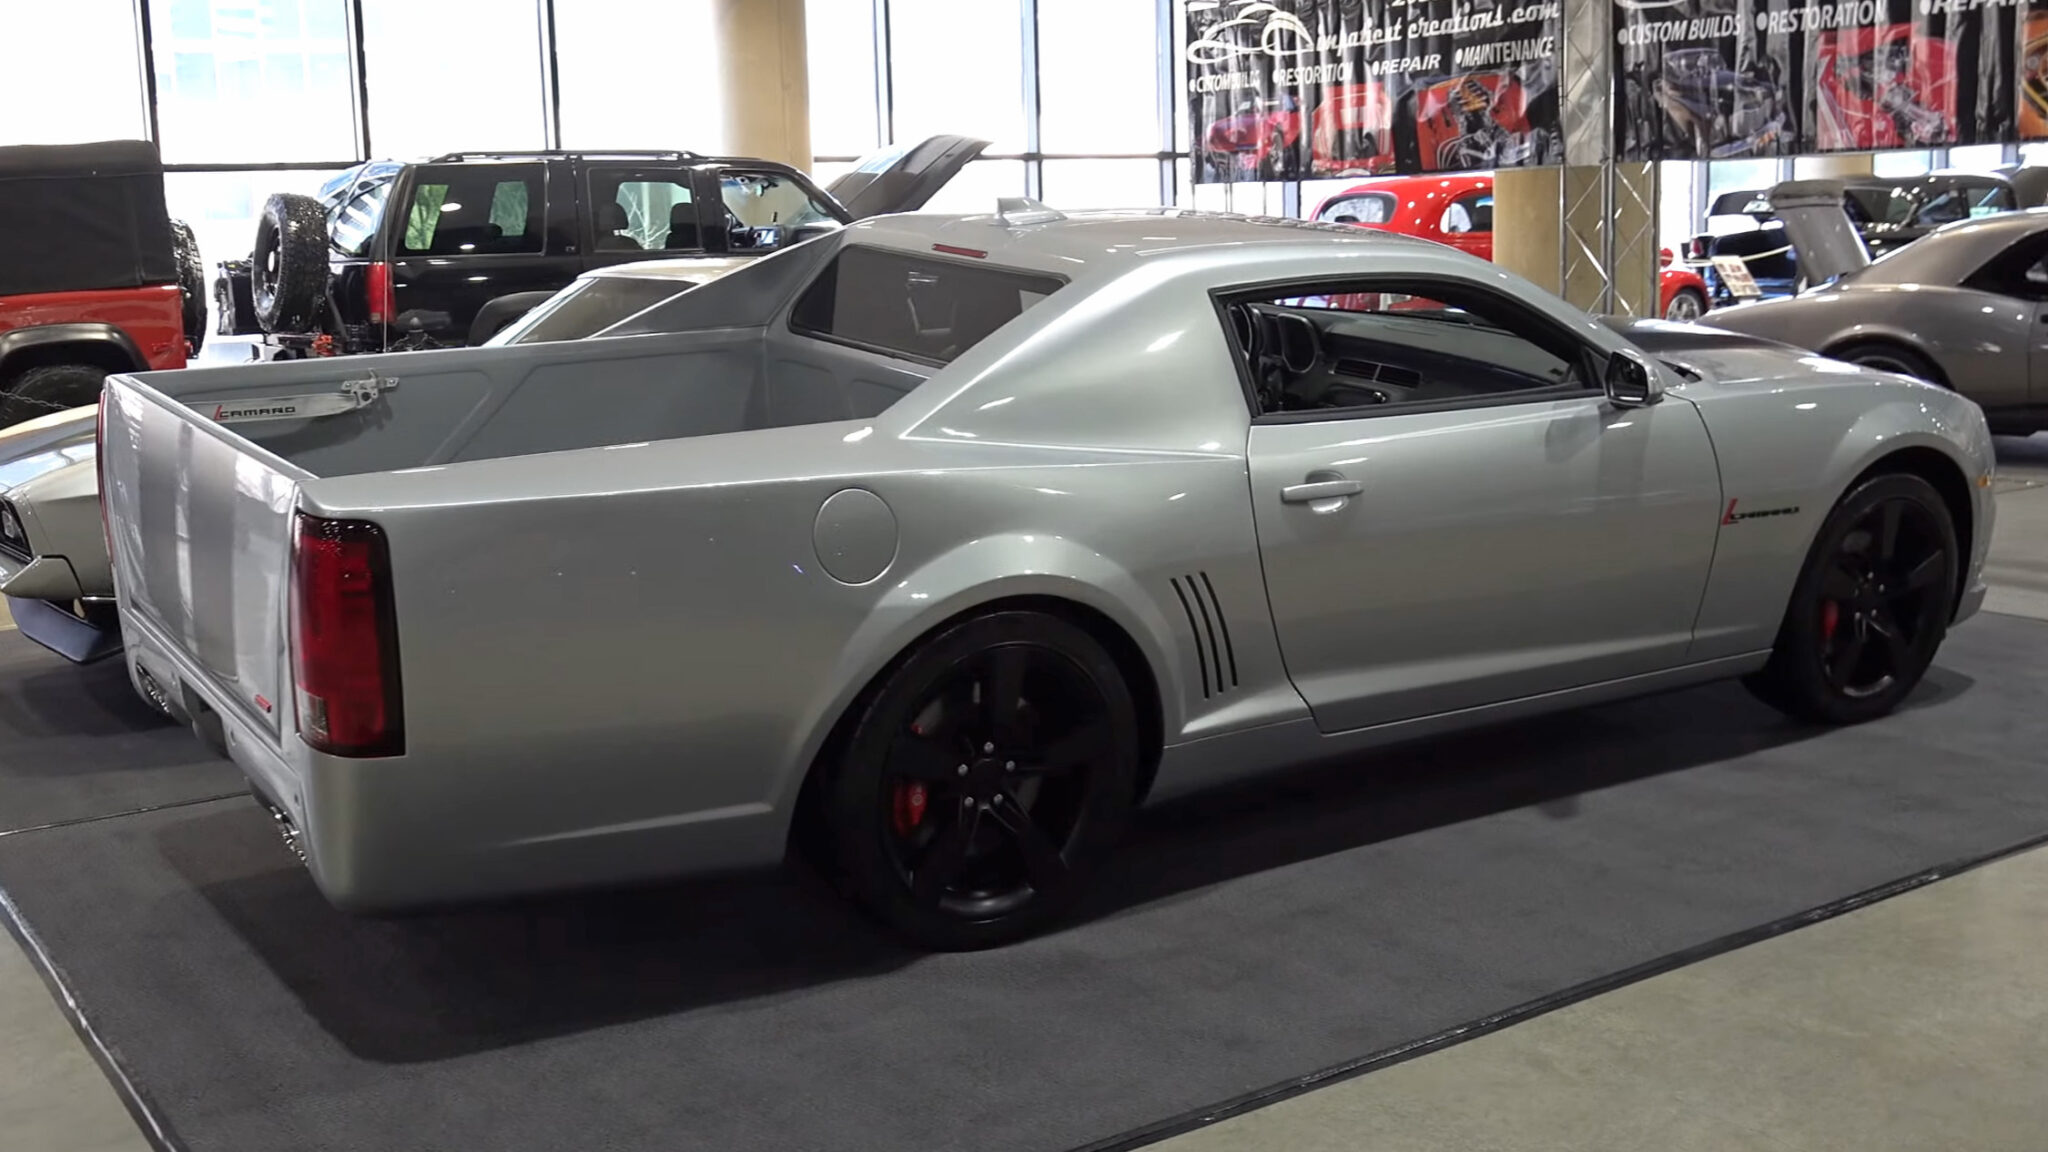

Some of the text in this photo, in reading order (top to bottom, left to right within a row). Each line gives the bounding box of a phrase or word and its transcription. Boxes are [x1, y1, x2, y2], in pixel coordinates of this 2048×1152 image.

[1628, 14, 1742, 46] CUSTOM BUILDS
[1768, 0, 1887, 34] RESTORATION
[1380, 54, 1441, 76] REPAIR
[1461, 36, 1555, 67] MAINTENANCE
